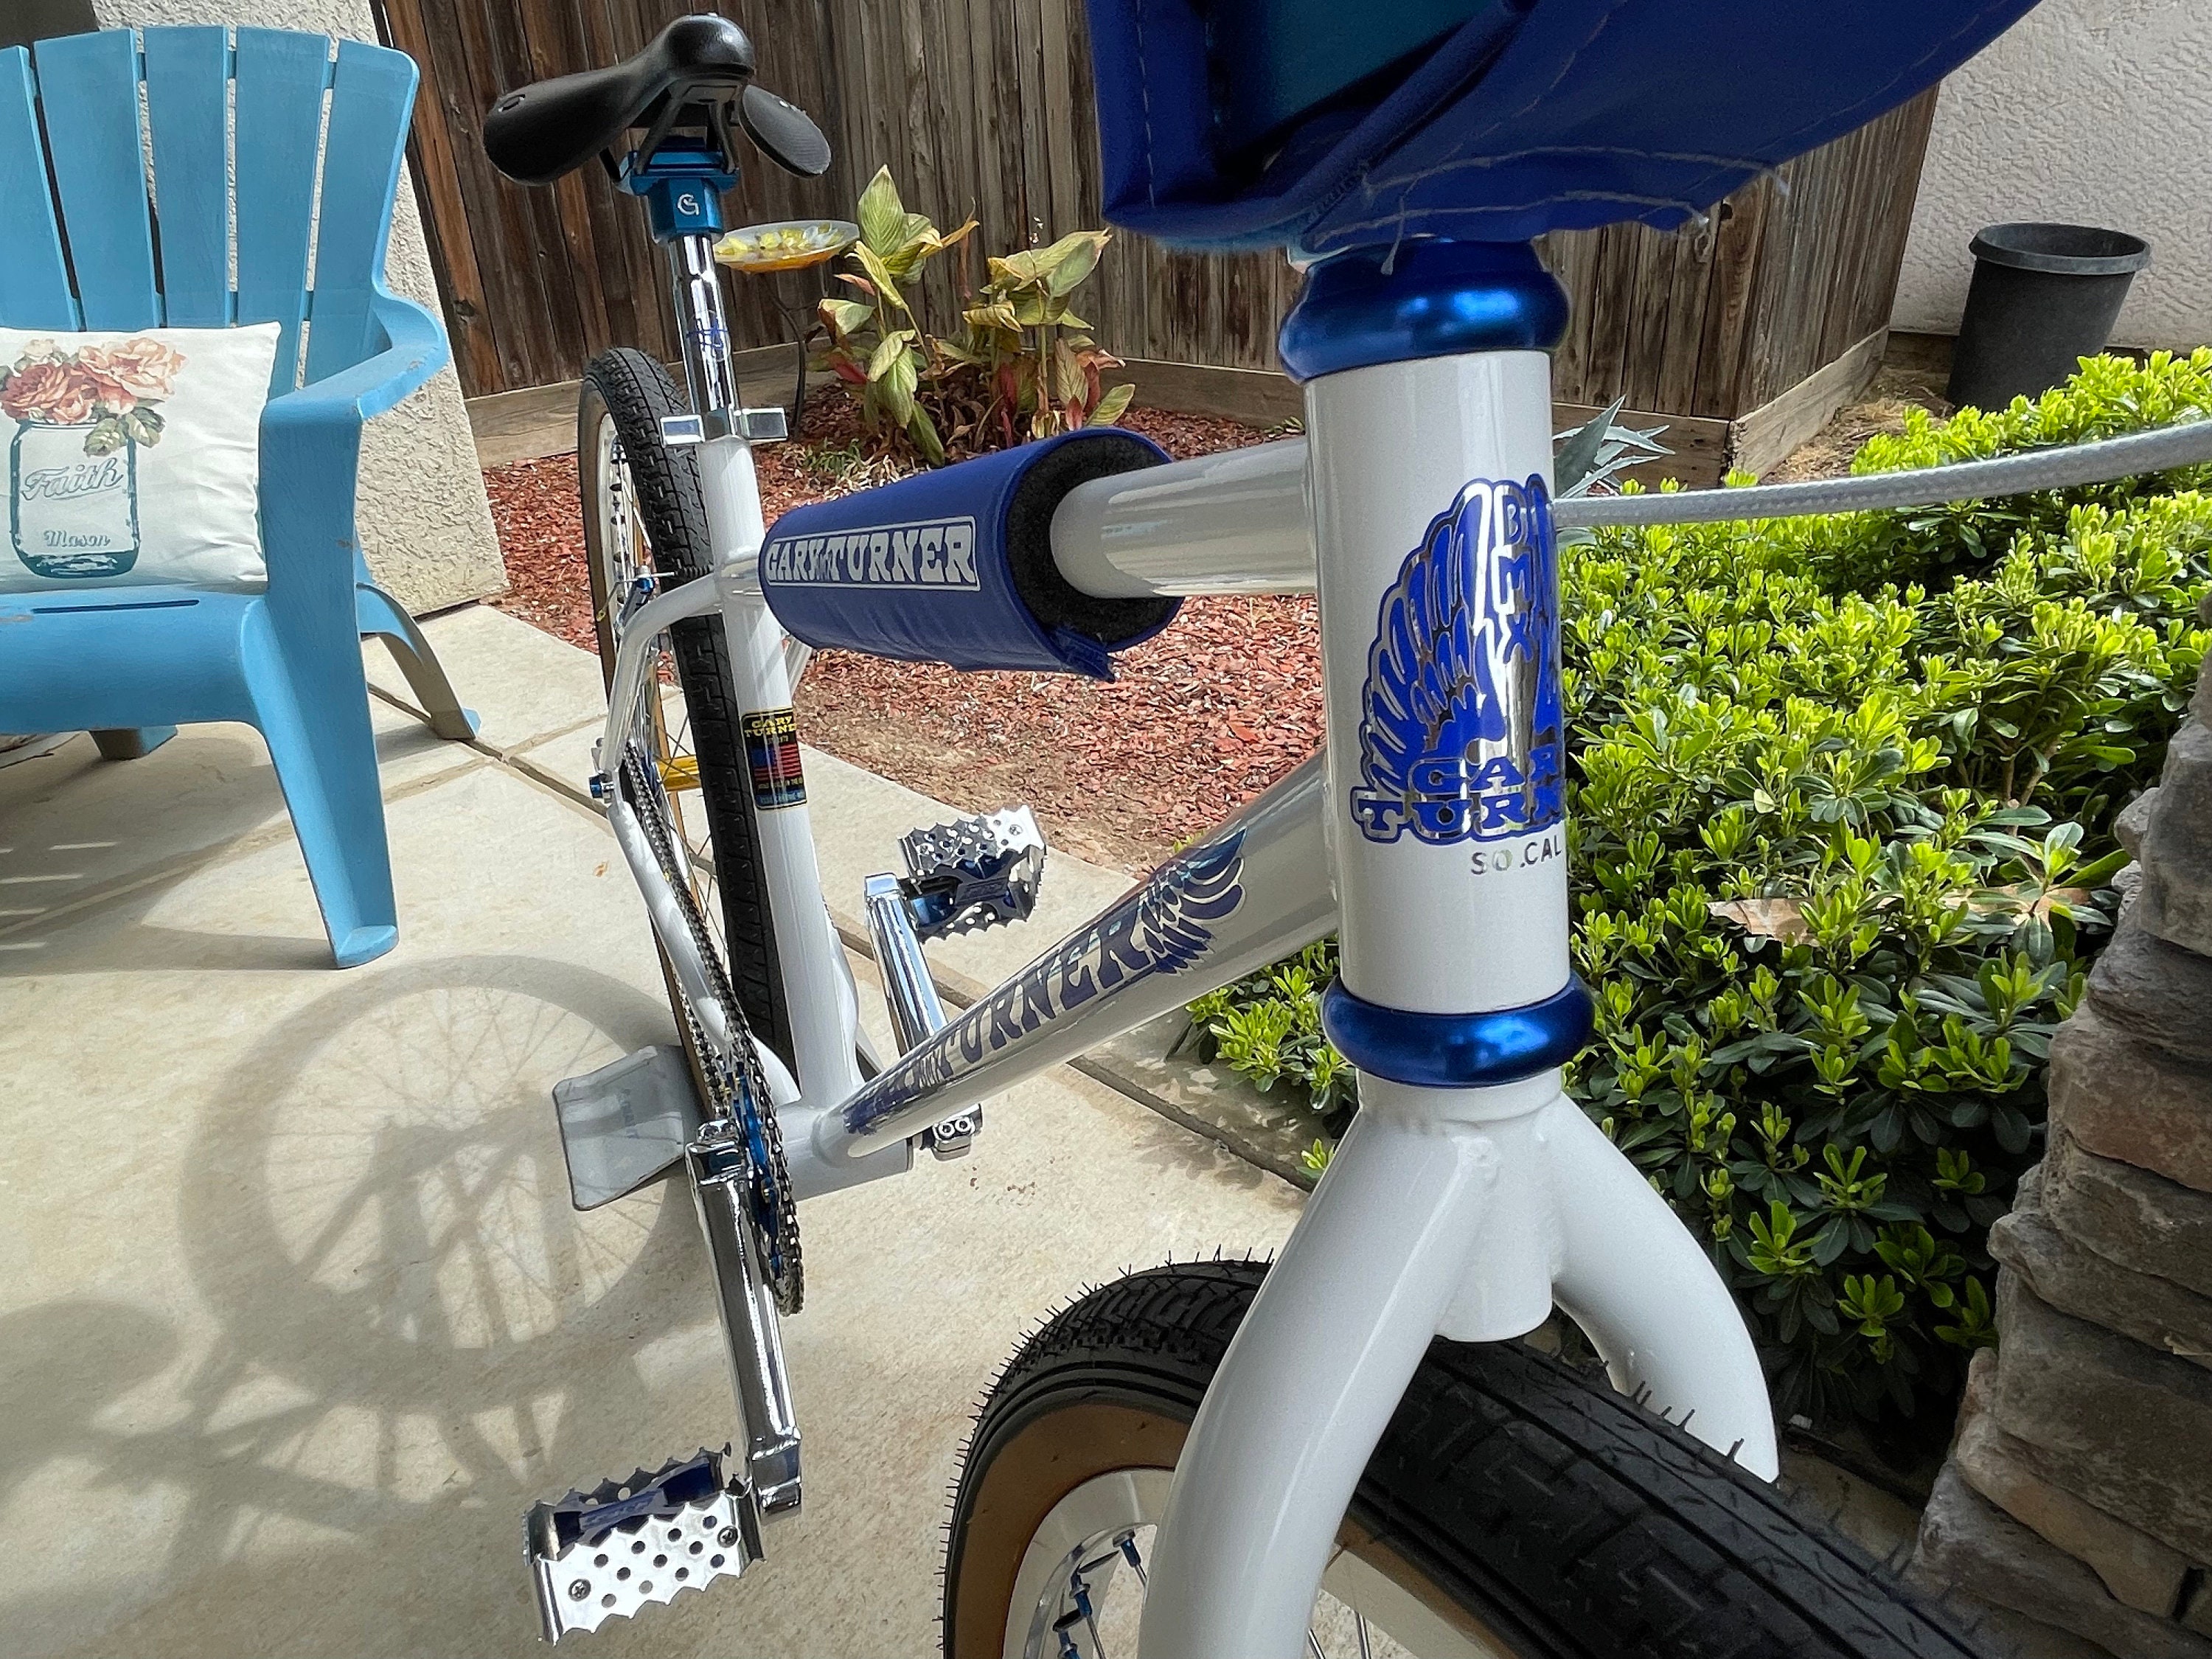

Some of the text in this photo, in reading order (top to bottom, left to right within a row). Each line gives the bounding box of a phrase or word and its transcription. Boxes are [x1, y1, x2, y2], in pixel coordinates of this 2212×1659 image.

[21, 457, 124, 501] Faith
[44, 529, 111, 548] Mason
[826, 524, 977, 584] TURNER
